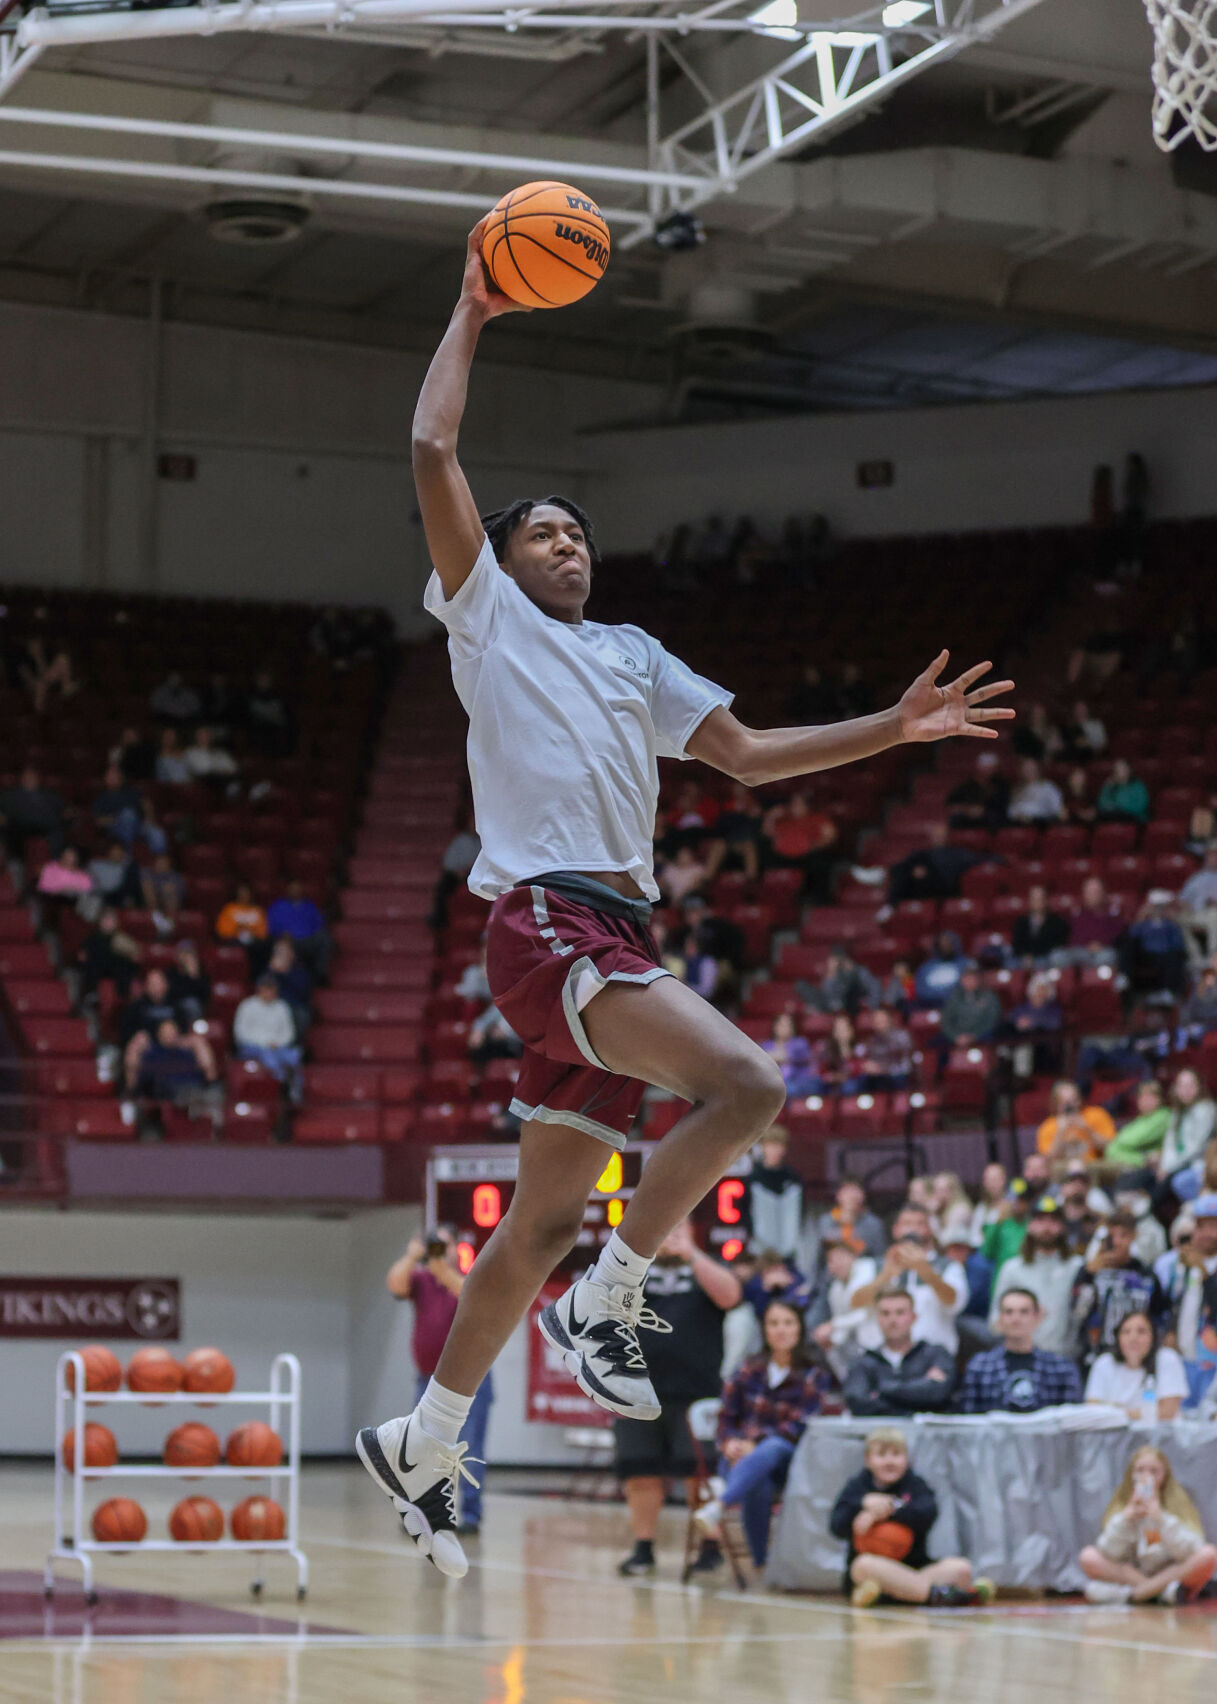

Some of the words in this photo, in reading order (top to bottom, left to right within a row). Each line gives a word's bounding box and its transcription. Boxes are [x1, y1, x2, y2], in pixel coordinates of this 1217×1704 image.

[555, 223, 609, 271] Wilson
[472, 1183, 501, 1228] 0
[0, 1291, 125, 1325] IKINGS
